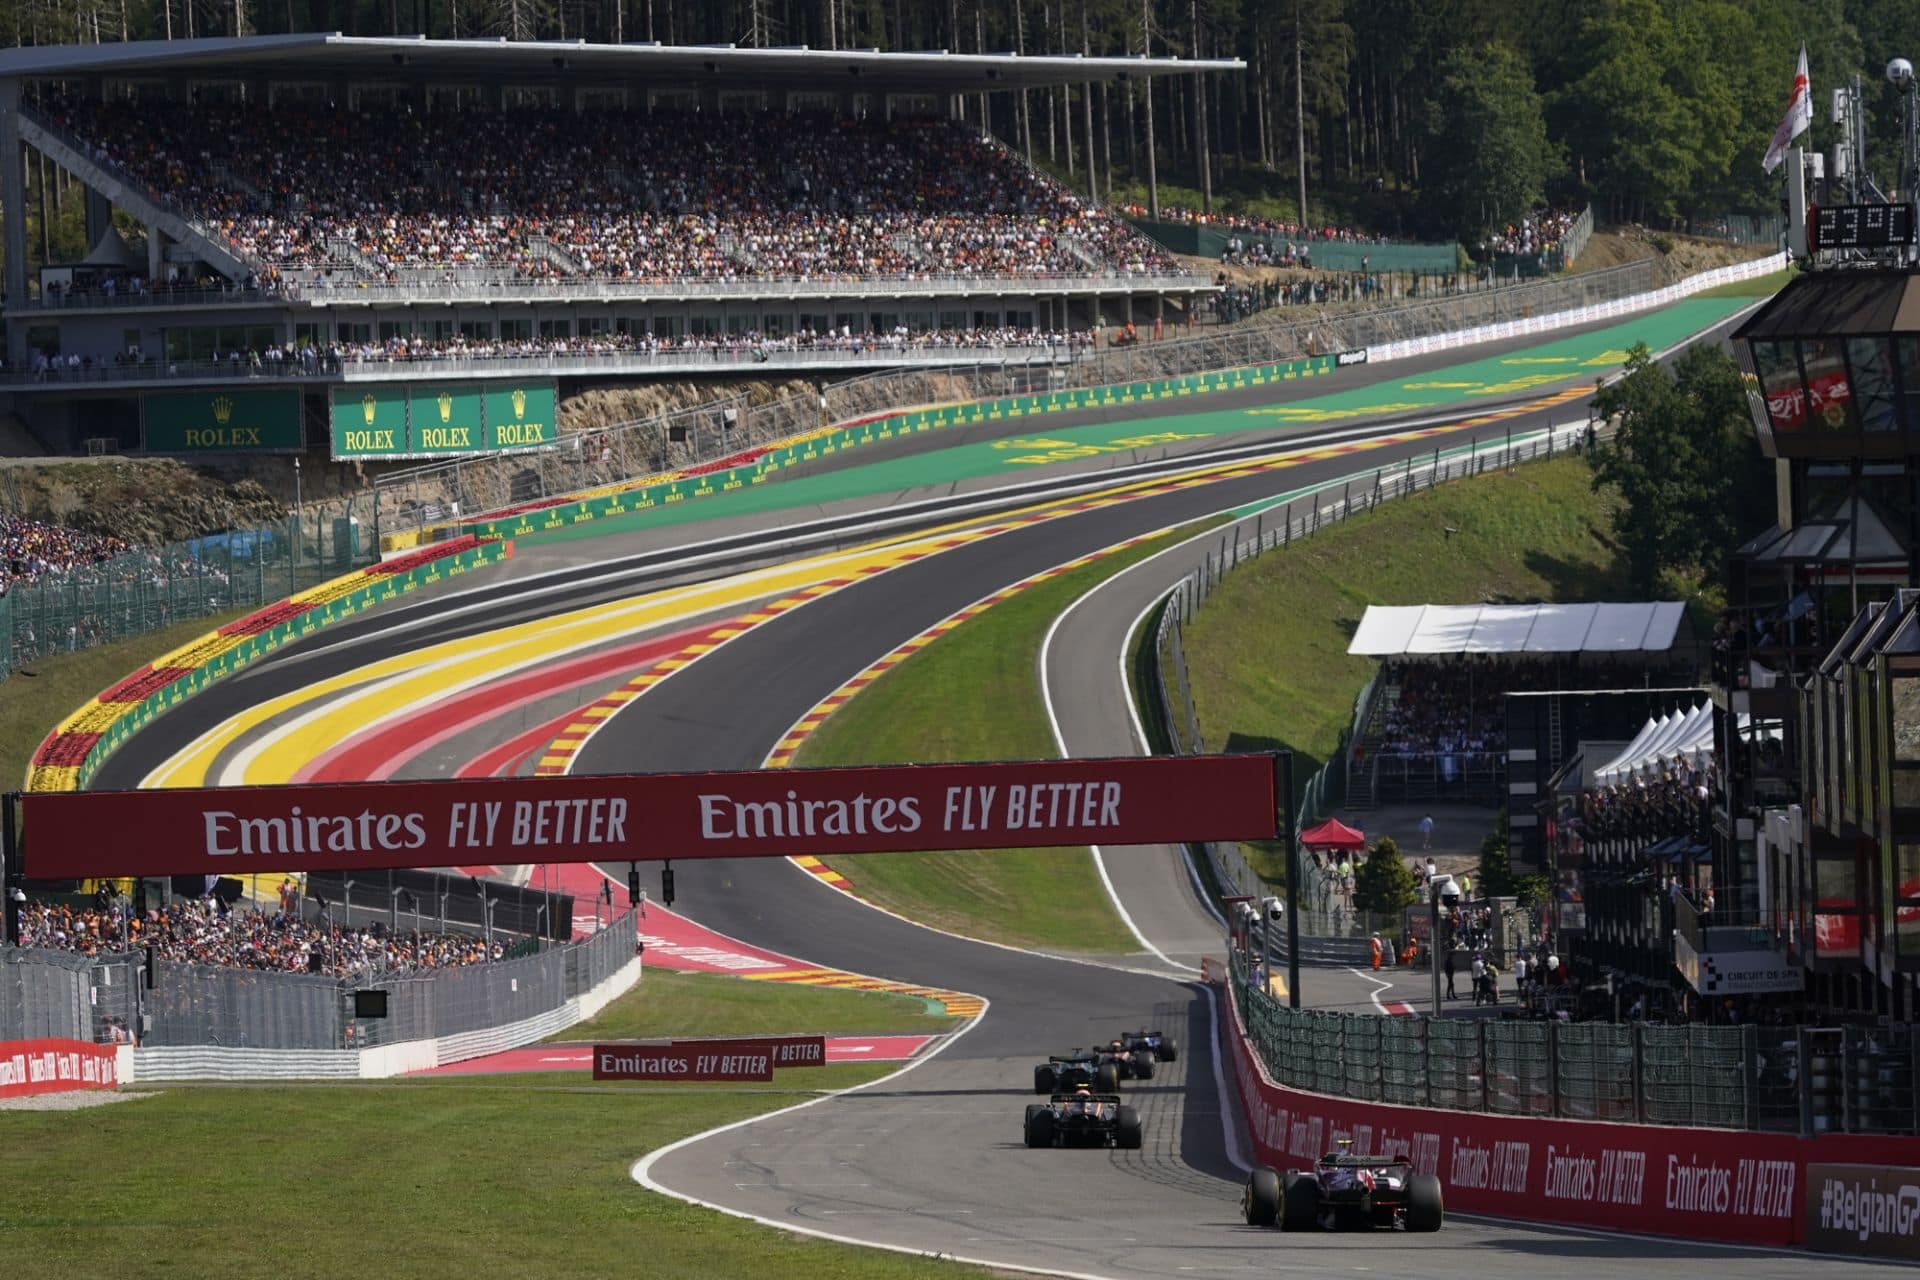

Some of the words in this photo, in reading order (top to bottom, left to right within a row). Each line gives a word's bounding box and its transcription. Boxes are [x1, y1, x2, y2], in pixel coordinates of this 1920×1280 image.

[184, 428, 260, 447] ROLEX
[346, 430, 395, 450] ROLEX
[422, 427, 470, 448] ROLEX
[497, 424, 544, 445] ROLEX
[698, 791, 921, 839] Emirates
[945, 786, 996, 831] FLY
[1006, 782, 1121, 829] BETTER
[203, 806, 426, 856] Emirates
[449, 801, 502, 848] FLY
[512, 798, 627, 845] BETTER
[781, 1044, 820, 1061] BETTER
[600, 1054, 688, 1074] Emirates
[696, 1055, 719, 1074] FLY
[720, 1055, 767, 1075] BETTER
[1451, 1136, 1490, 1189] Emirates
[1545, 1144, 1596, 1200] Emirates
[1597, 1149, 1615, 1202] FLY
[1612, 1150, 1646, 1205] BETTER
[1666, 1153, 1731, 1213] Emirates
[1733, 1159, 1755, 1215] FLY
[1753, 1159, 1796, 1218] BETTER
